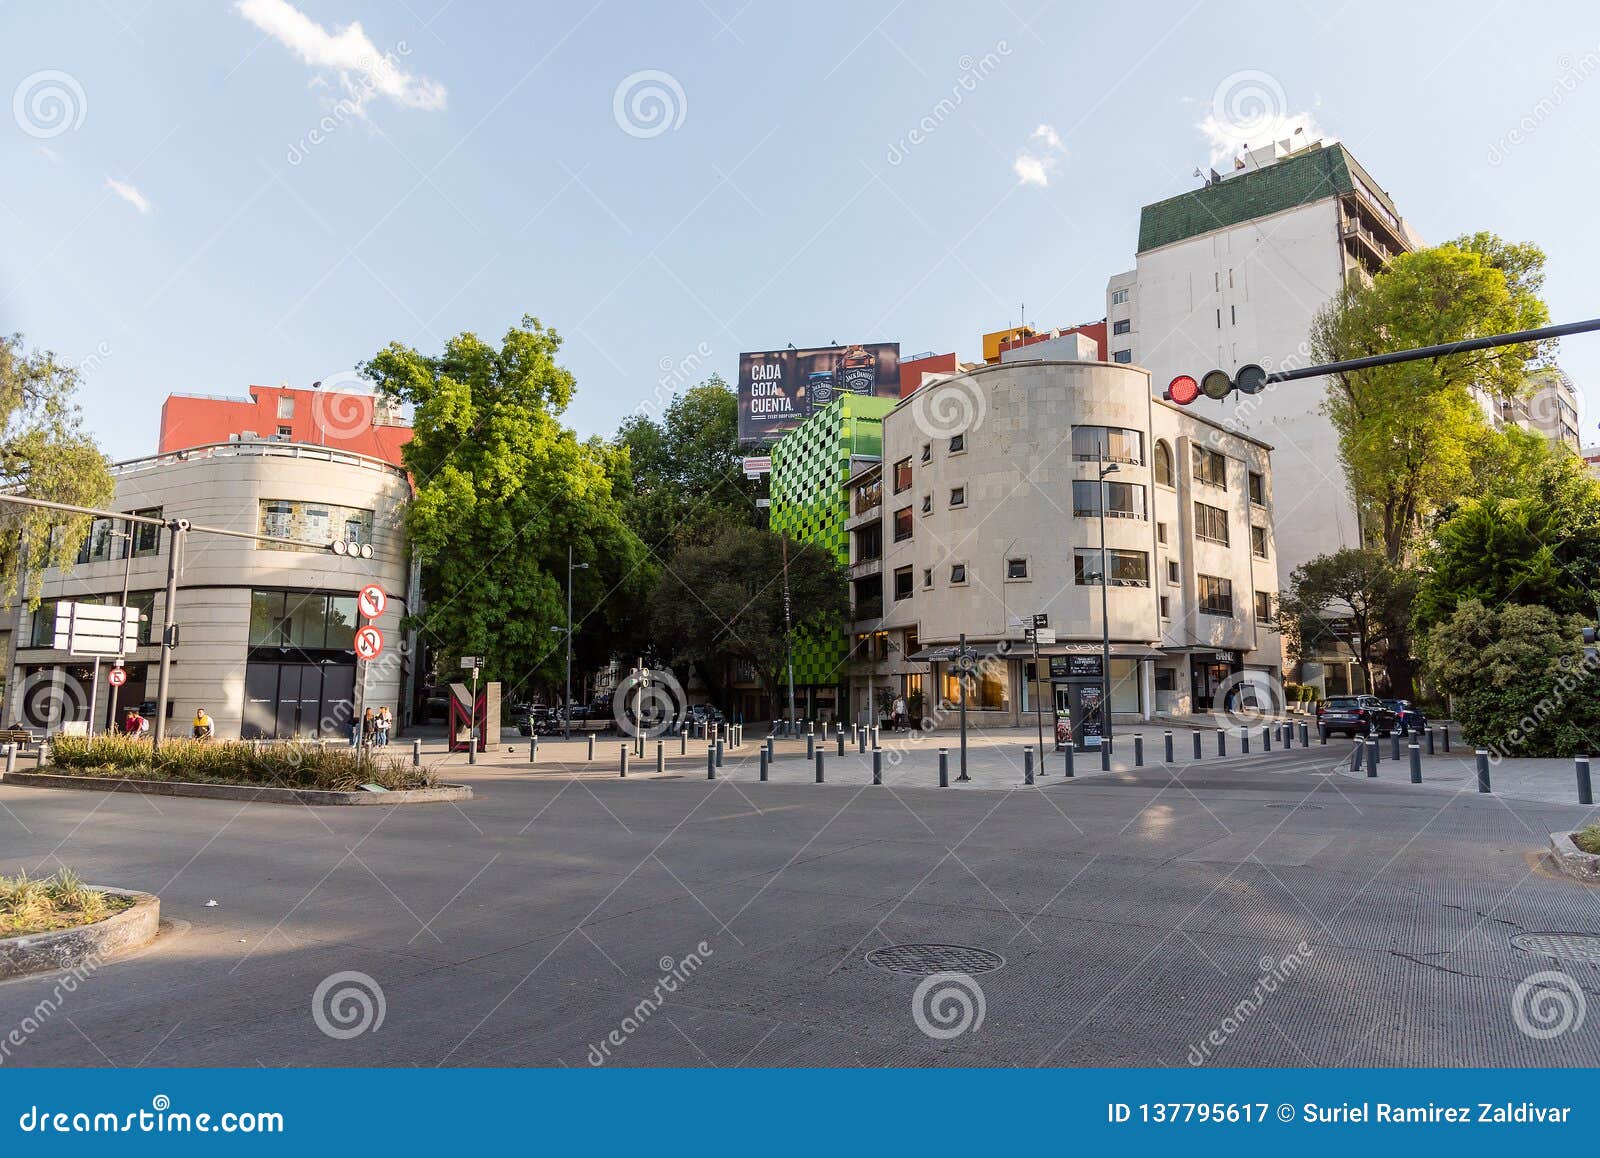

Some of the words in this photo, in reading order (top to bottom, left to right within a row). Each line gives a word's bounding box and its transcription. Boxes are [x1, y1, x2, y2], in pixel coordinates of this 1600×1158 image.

[752, 364, 782, 380] CADA
[752, 381, 778, 397] GOTA
[752, 397, 794, 413] CUENTA.
